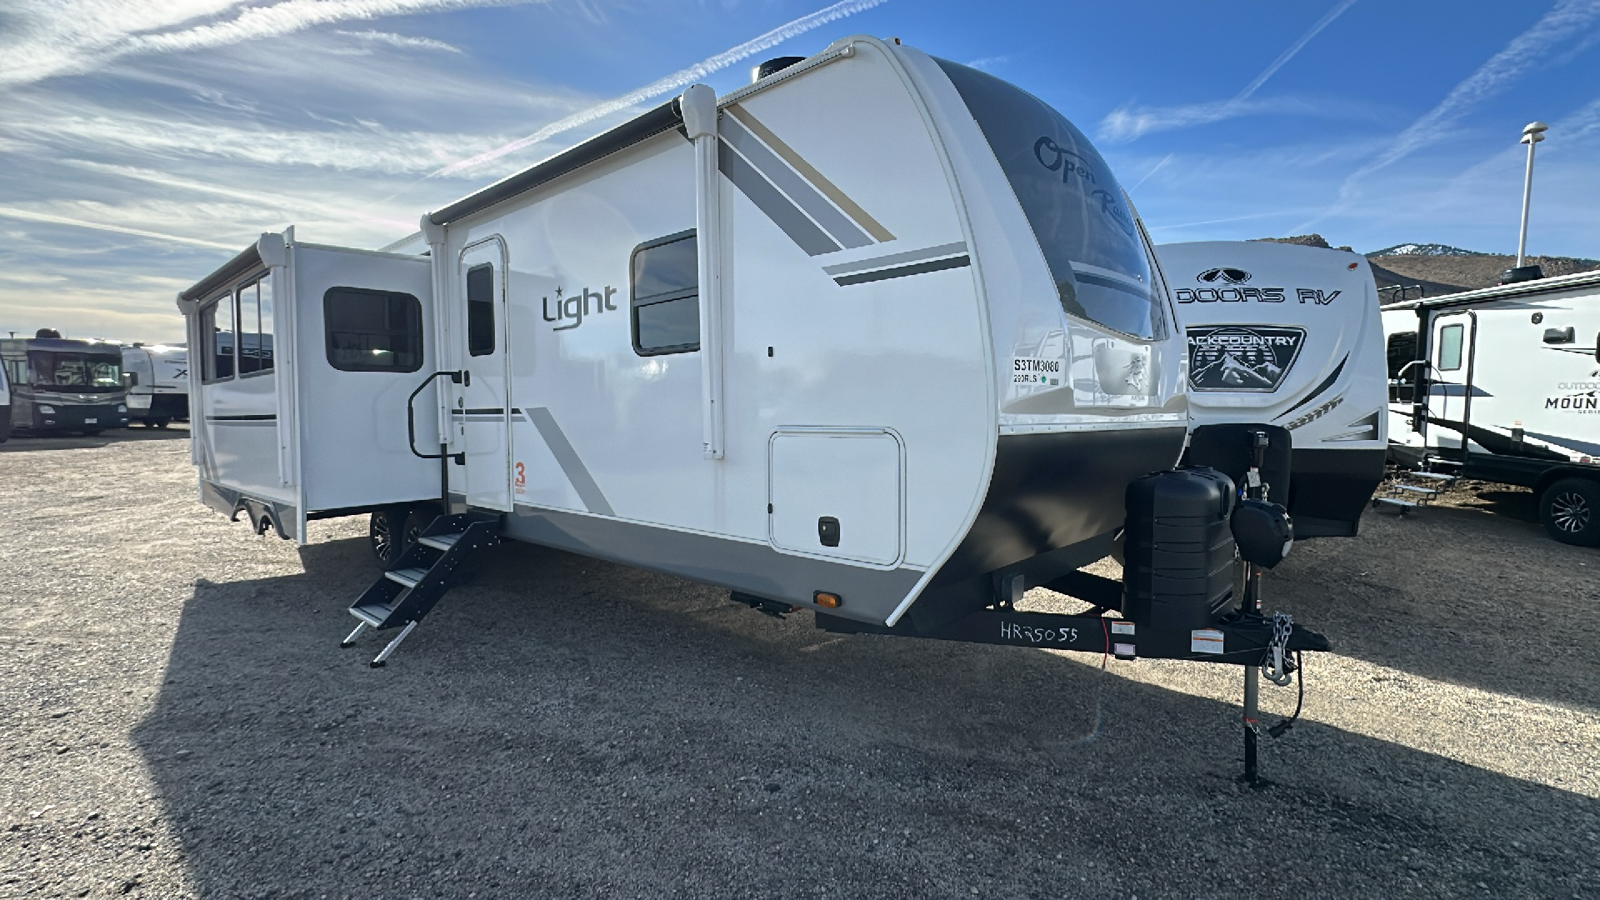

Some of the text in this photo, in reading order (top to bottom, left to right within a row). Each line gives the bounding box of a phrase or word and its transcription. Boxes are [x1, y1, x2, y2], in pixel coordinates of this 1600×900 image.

[1033, 136, 1096, 184] Open
[1296, 288, 1342, 305] RV
[542, 285, 617, 332] Light
[1014, 359, 1059, 373] S3TM3080
[1545, 398, 1598, 409] MOUN
